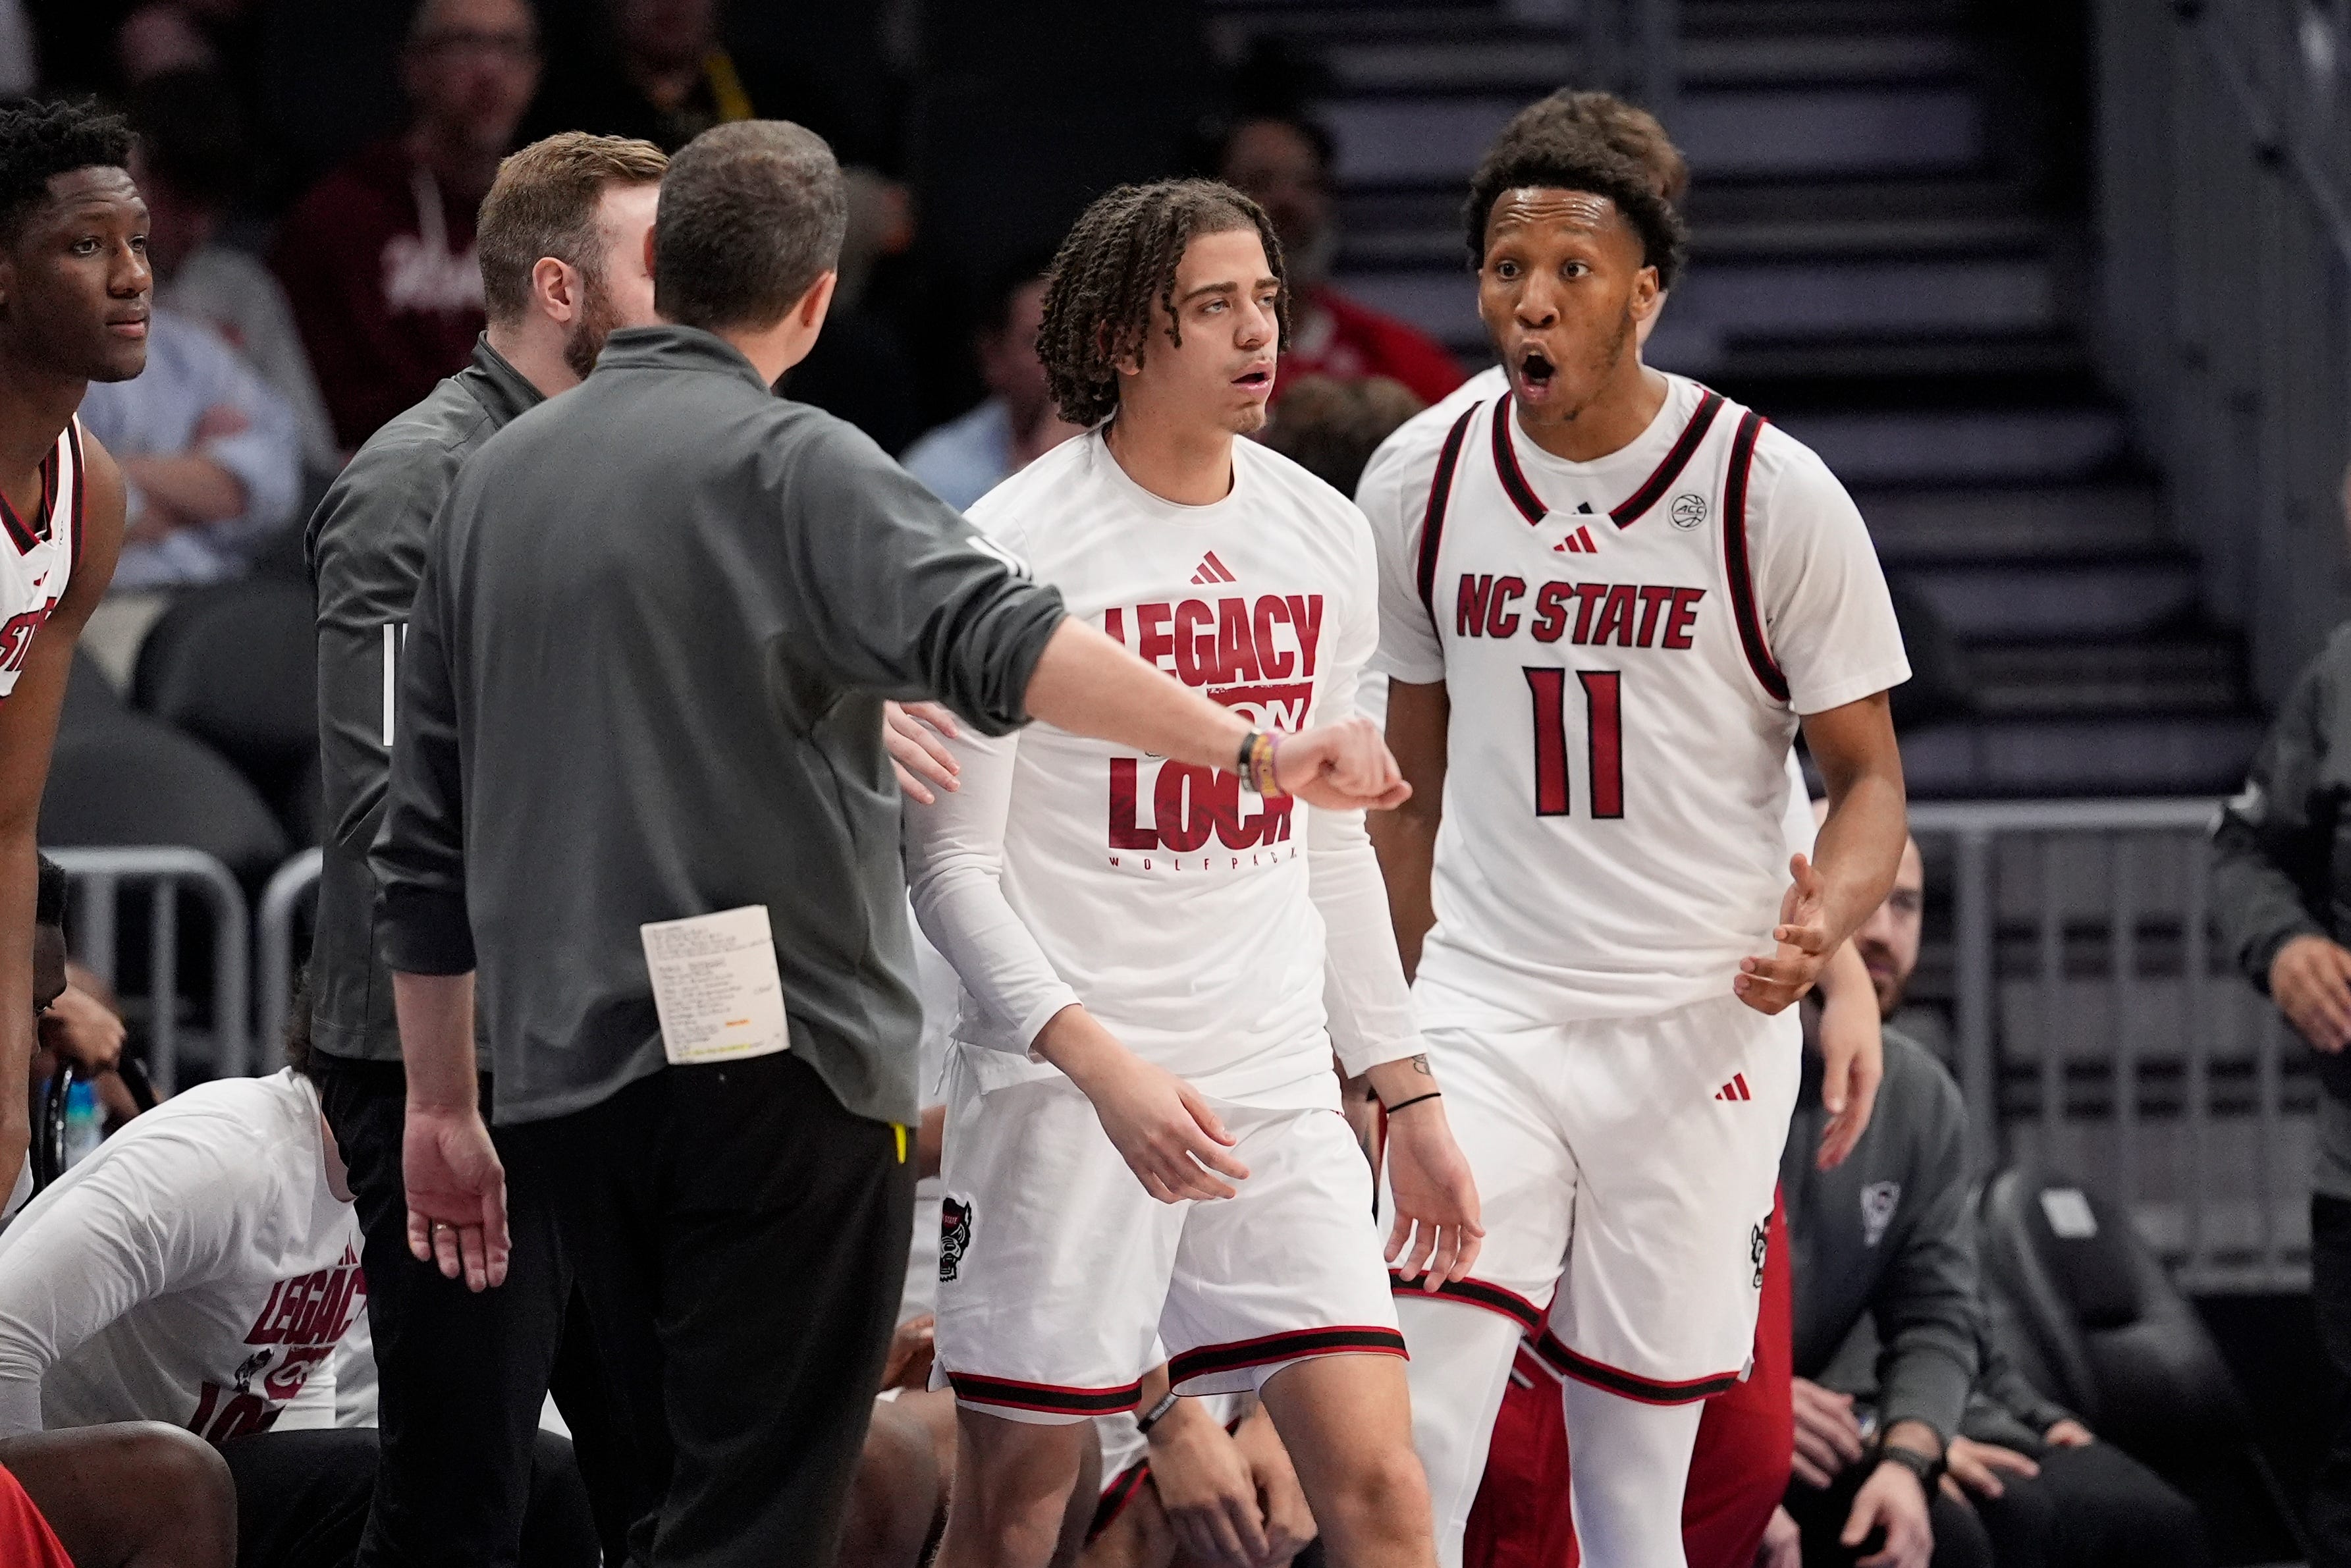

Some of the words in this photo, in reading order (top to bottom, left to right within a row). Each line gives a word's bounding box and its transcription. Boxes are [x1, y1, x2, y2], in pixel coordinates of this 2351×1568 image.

[1675, 504, 1705, 514] ACC
[1457, 574, 1527, 639] NC
[1531, 580, 1707, 651] STATE
[1521, 665, 1624, 819] 11
[244, 1266, 368, 1345] LEGAC
